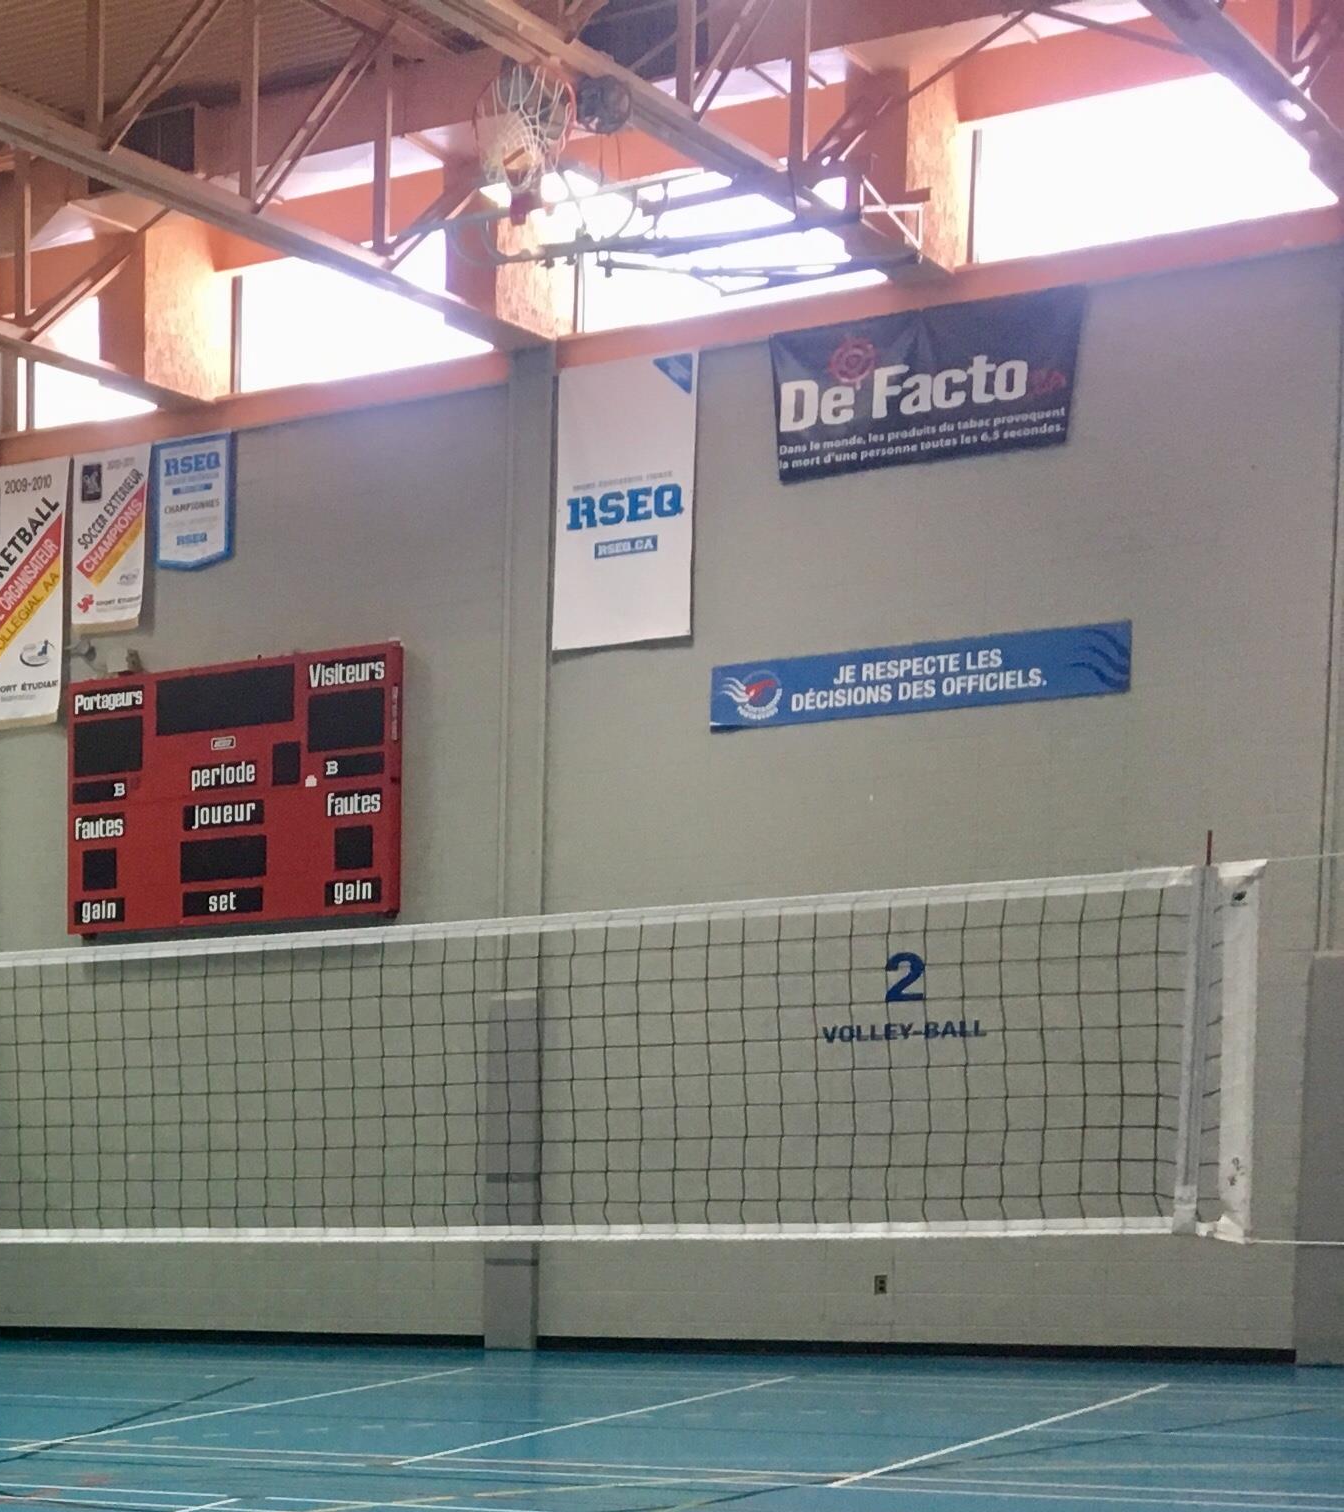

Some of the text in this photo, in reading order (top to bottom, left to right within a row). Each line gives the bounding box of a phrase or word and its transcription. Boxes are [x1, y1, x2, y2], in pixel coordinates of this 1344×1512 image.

[779, 379, 856, 433] De
[872, 354, 1029, 419] Facto
[779, 407, 1066, 456] Dans le monde, les produits du tabac provoquent
[164, 451, 221, 478] RSEQ
[791, 456, 820, 469] mort
[823, 451, 858, 465] d'une
[860, 444, 918, 461] personne
[920, 437, 958, 451] toutes
[960, 434, 978, 445] les
[3, 473, 53, 495] 2009-2010
[566, 482, 685, 531] RSEQ
[78, 513, 110, 550] SOCCER
[83, 498, 144, 574] CHAMPIONS
[597, 537, 654, 557] RSEQ.CA
[42, 570, 61, 593] AA
[308, 659, 386, 688] Visiteurs
[833, 648, 1003, 685] JE RESPECTE LES
[74, 688, 144, 715] Portageurs
[790, 684, 893, 713] DÉCISIONS
[898, 679, 937, 701] DES
[941, 667, 1048, 697] OFFICIELS.
[191, 761, 256, 791] periode
[325, 760, 339, 776] B
[113, 782, 126, 797] B
[192, 802, 256, 830] joueur
[326, 792, 382, 817] fautes
[75, 817, 124, 841] fautes
[208, 891, 237, 912] set
[333, 880, 373, 905] gain
[81, 900, 117, 924] gain
[884, 951, 927, 1002] 2
[822, 1019, 988, 1044] VOLLEY-BALL
